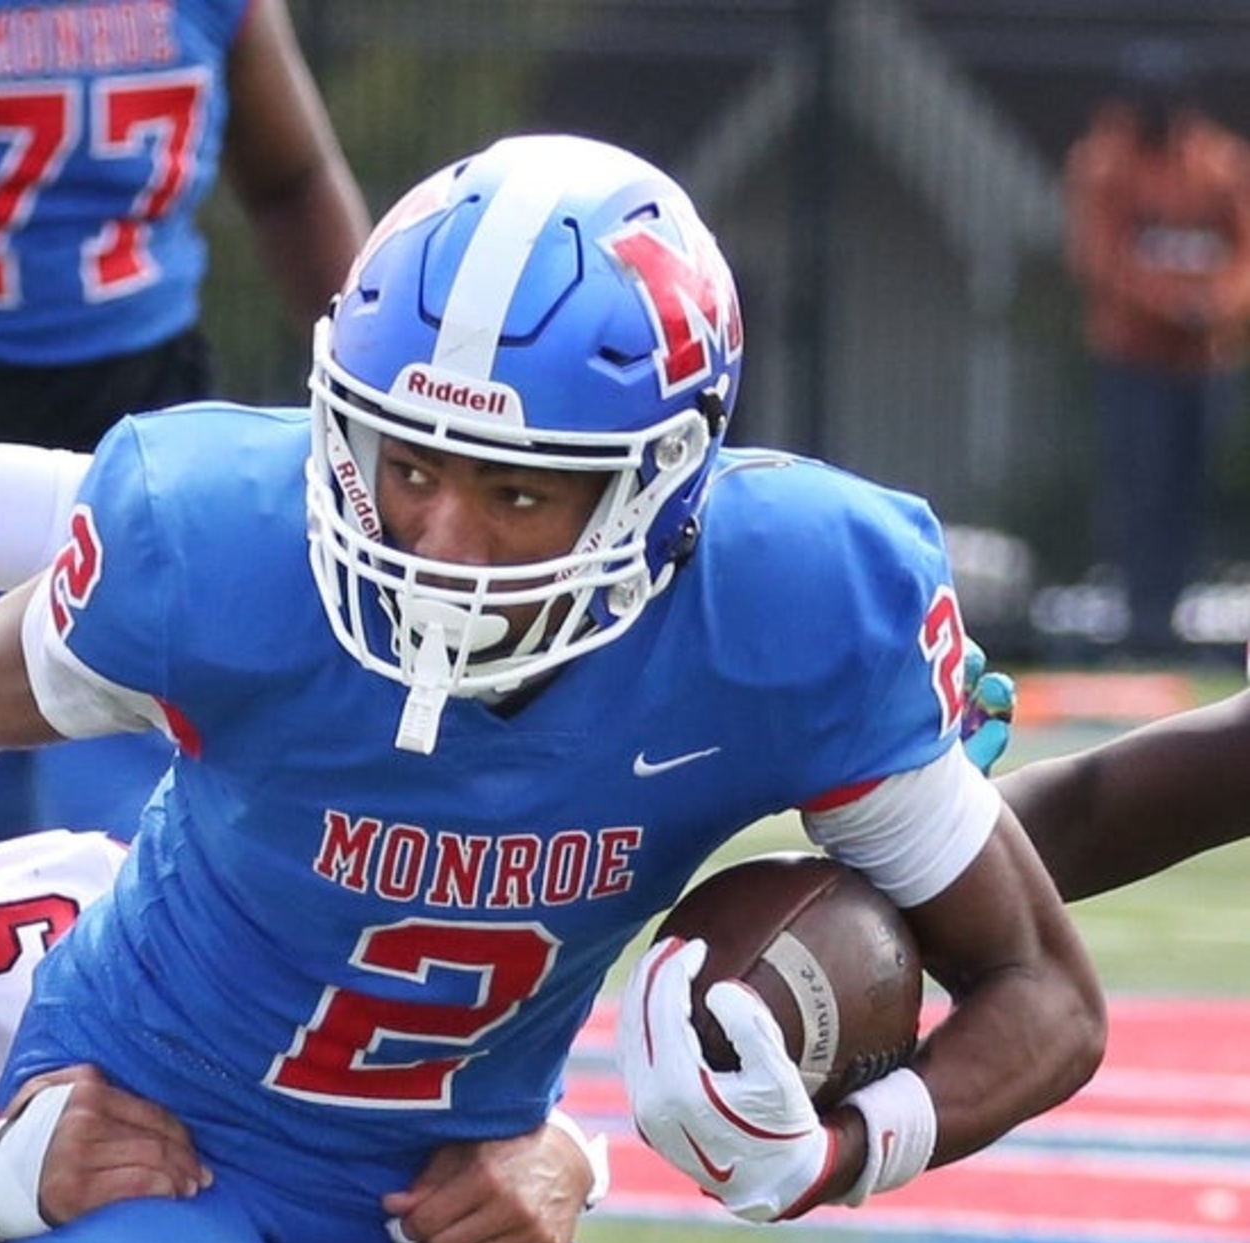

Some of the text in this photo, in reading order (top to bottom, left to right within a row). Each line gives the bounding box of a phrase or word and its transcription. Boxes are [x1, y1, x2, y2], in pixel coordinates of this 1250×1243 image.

[408, 370, 507, 415] Riddell
[50, 503, 103, 638] 2
[918, 584, 966, 740] 2
[313, 809, 644, 909] MONROE
[263, 917, 563, 1110] 2
